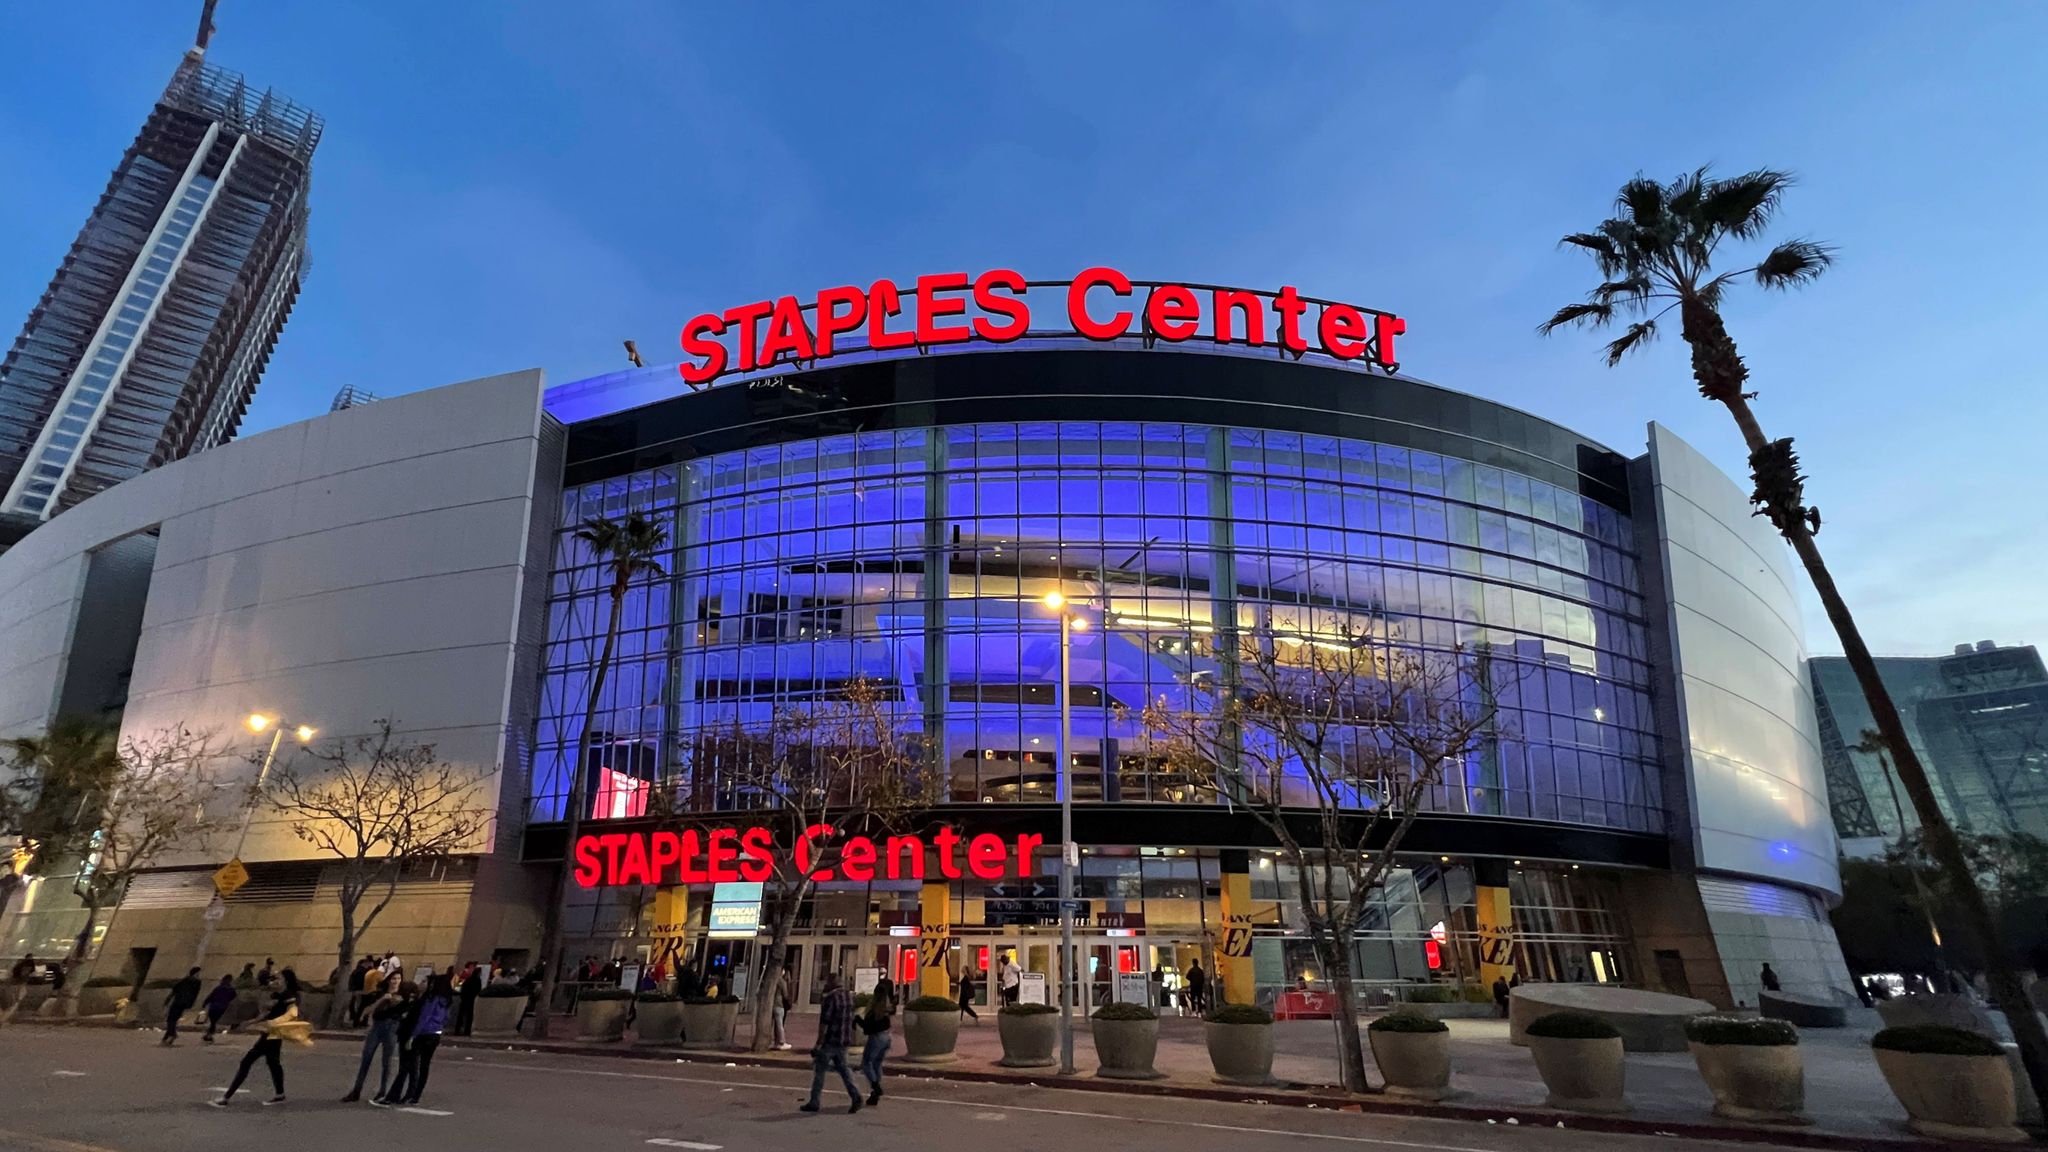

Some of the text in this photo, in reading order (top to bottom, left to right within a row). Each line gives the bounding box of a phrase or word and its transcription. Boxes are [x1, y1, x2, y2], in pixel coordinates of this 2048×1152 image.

[679, 266, 1406, 384] STAPLES Center
[574, 823, 1043, 889] STAPLES Center
[714, 906, 757, 916] AMERICAN
[718, 915, 757, 925] EXPRESS
